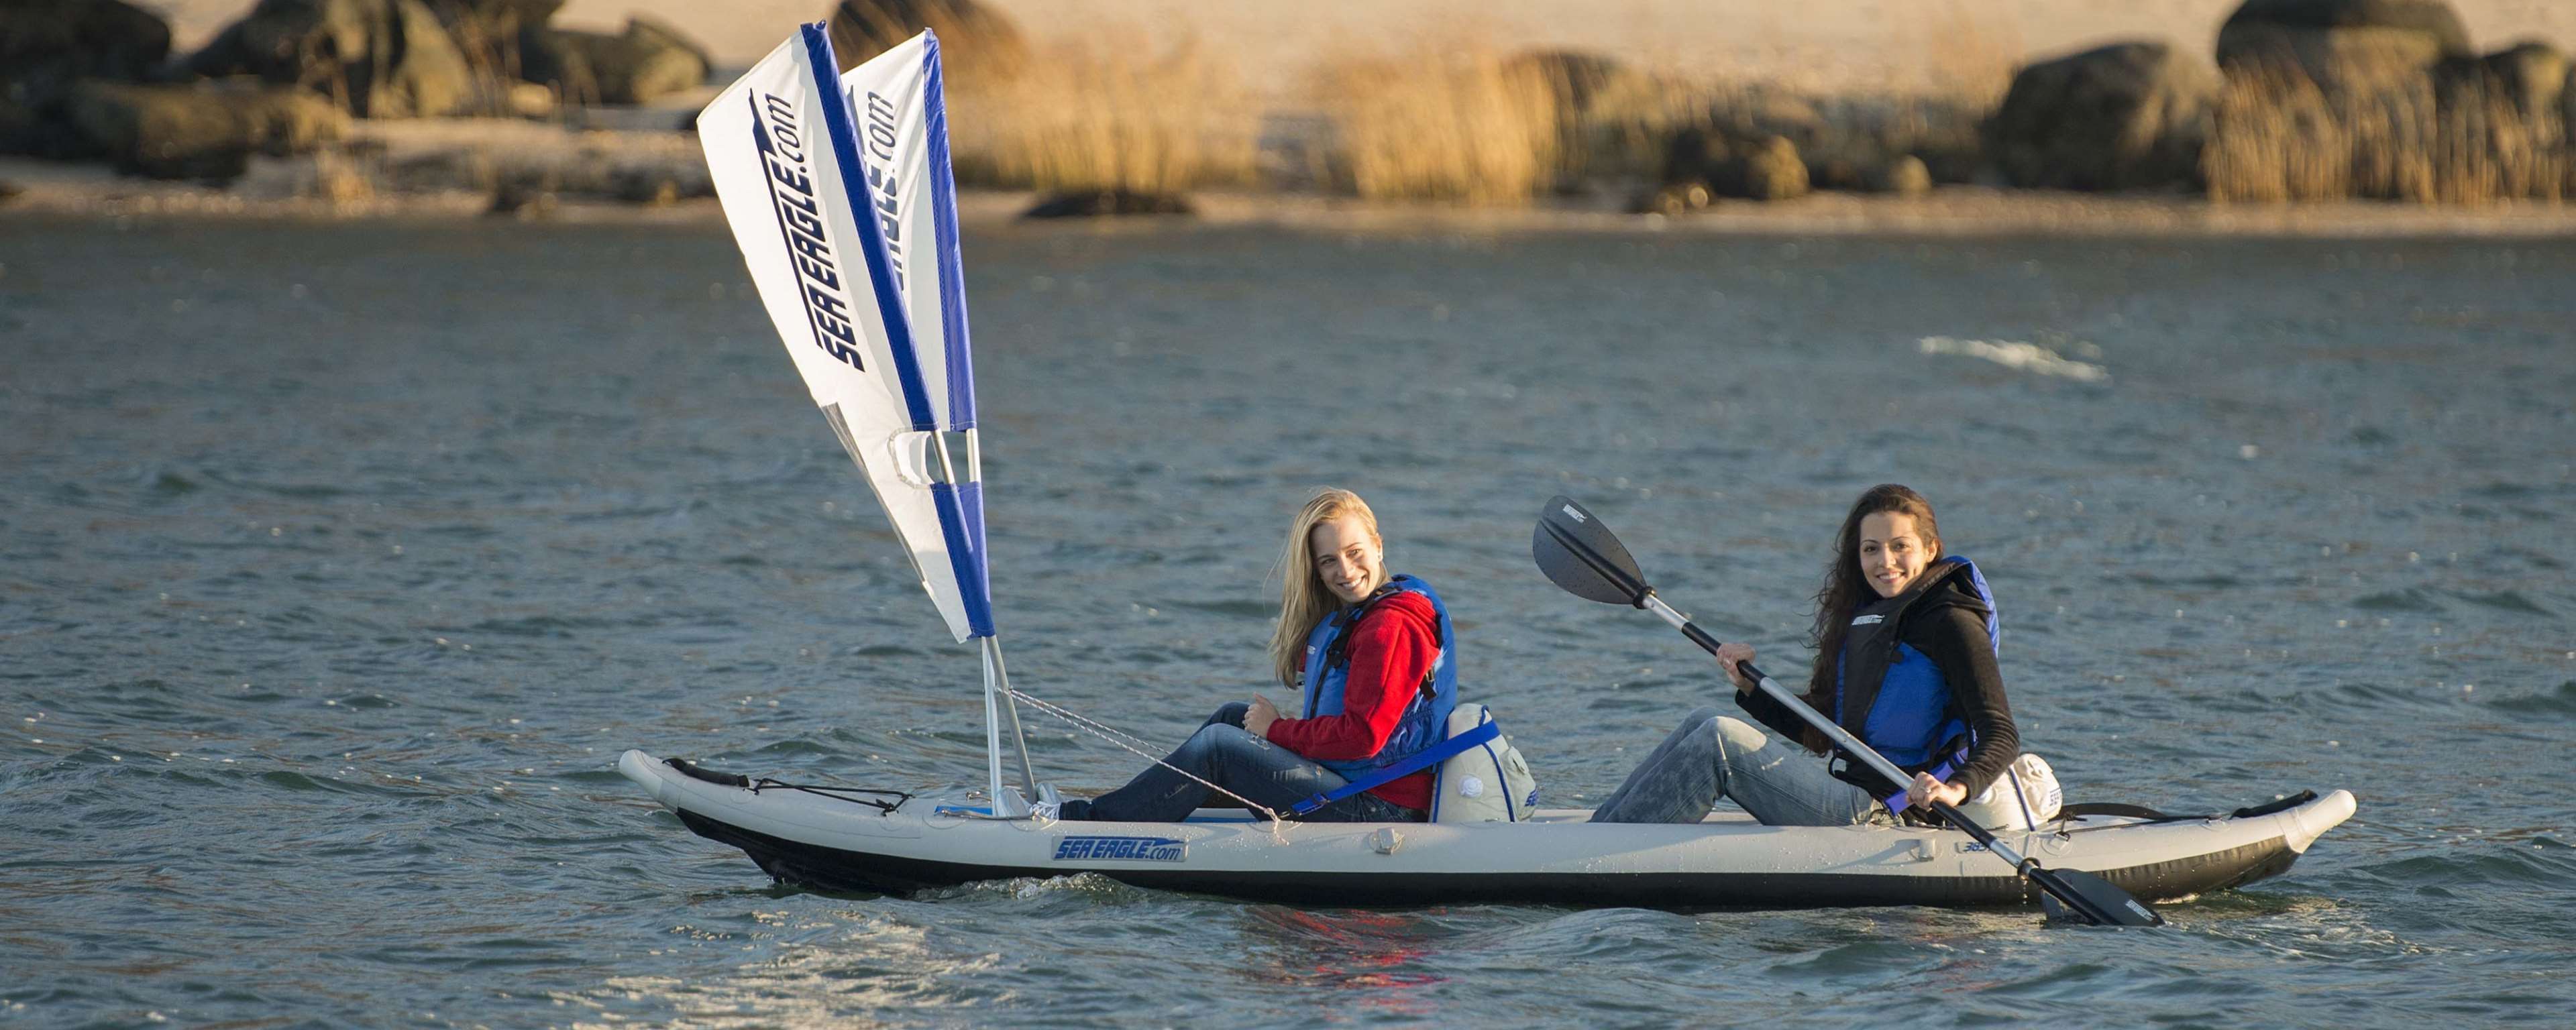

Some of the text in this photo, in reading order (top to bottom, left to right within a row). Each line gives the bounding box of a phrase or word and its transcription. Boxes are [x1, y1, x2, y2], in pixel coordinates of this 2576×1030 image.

[764, 93, 865, 373] SEA EAGLE.com
[1054, 839, 1182, 860] SEA EAGLE.com
